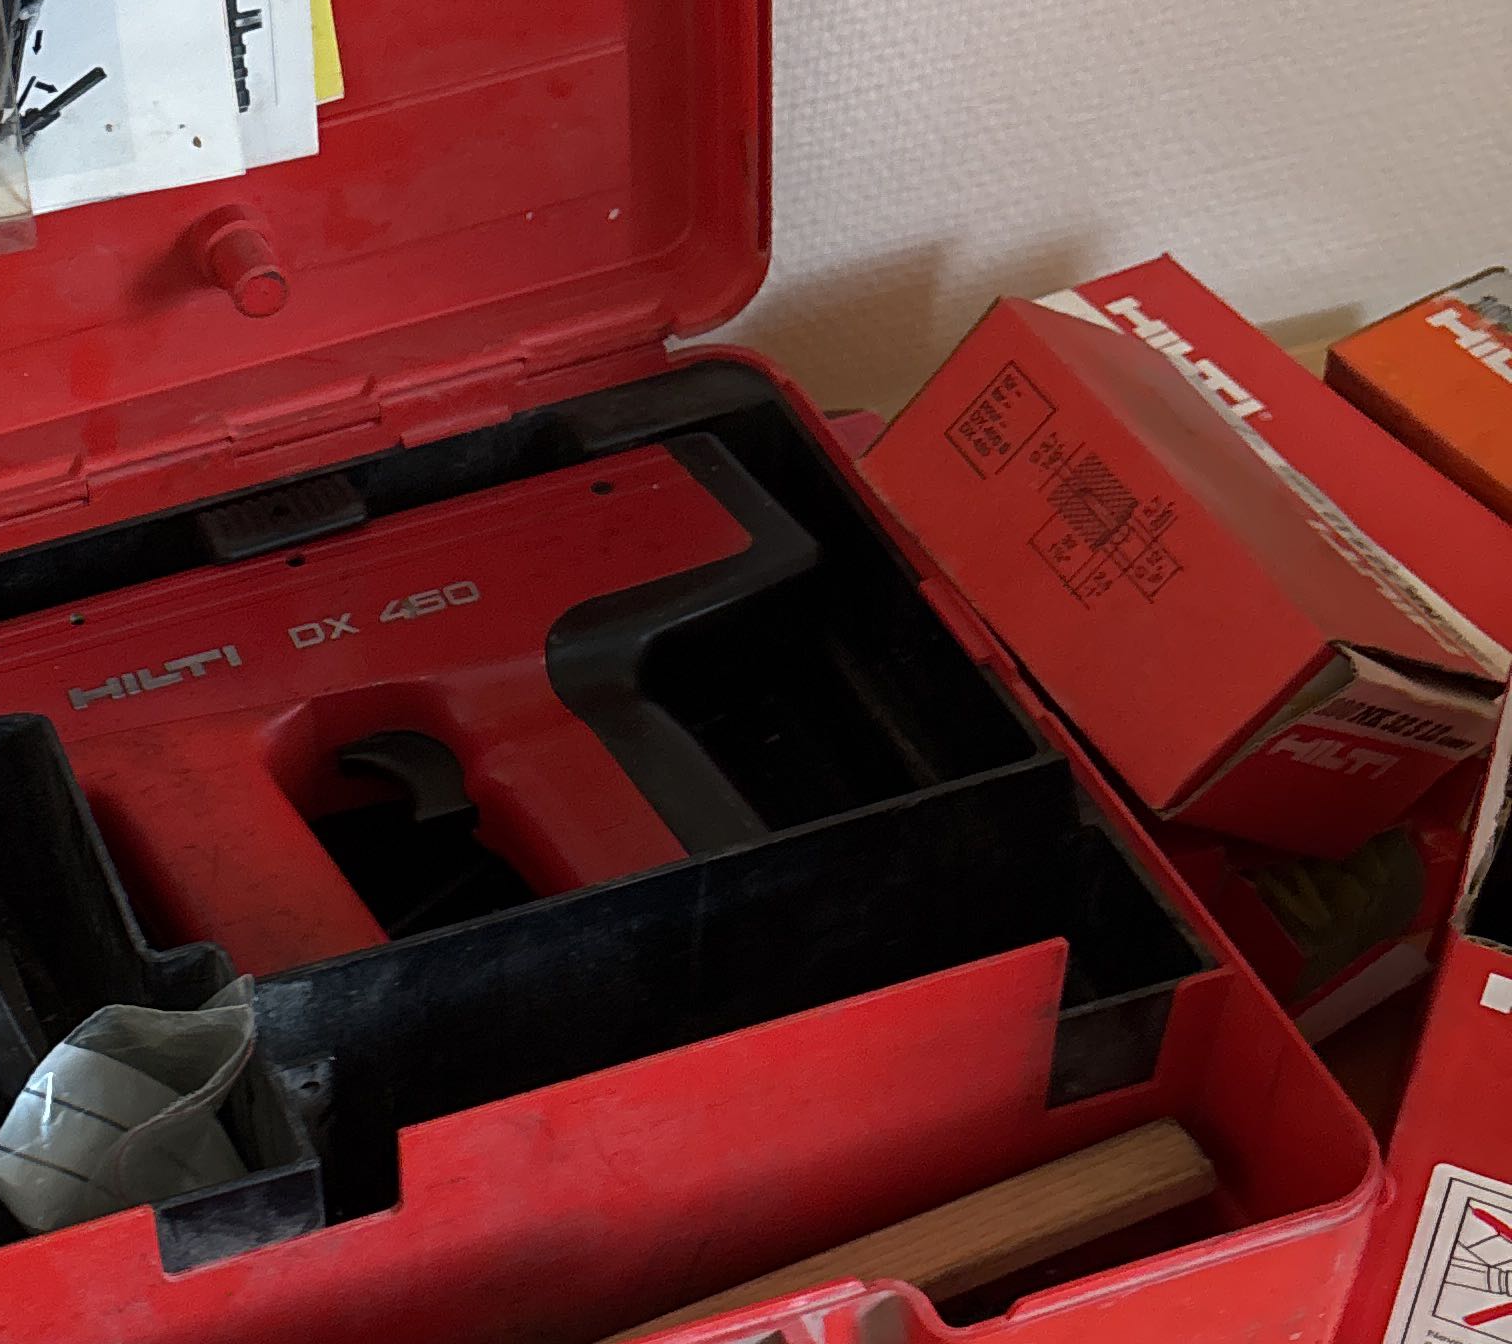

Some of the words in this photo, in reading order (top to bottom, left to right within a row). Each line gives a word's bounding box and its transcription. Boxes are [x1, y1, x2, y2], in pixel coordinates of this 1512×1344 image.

[1104, 297, 1264, 421] HILTI
[288, 613, 360, 649] DX
[379, 580, 480, 624] 450
[68, 645, 243, 710] HILTI
